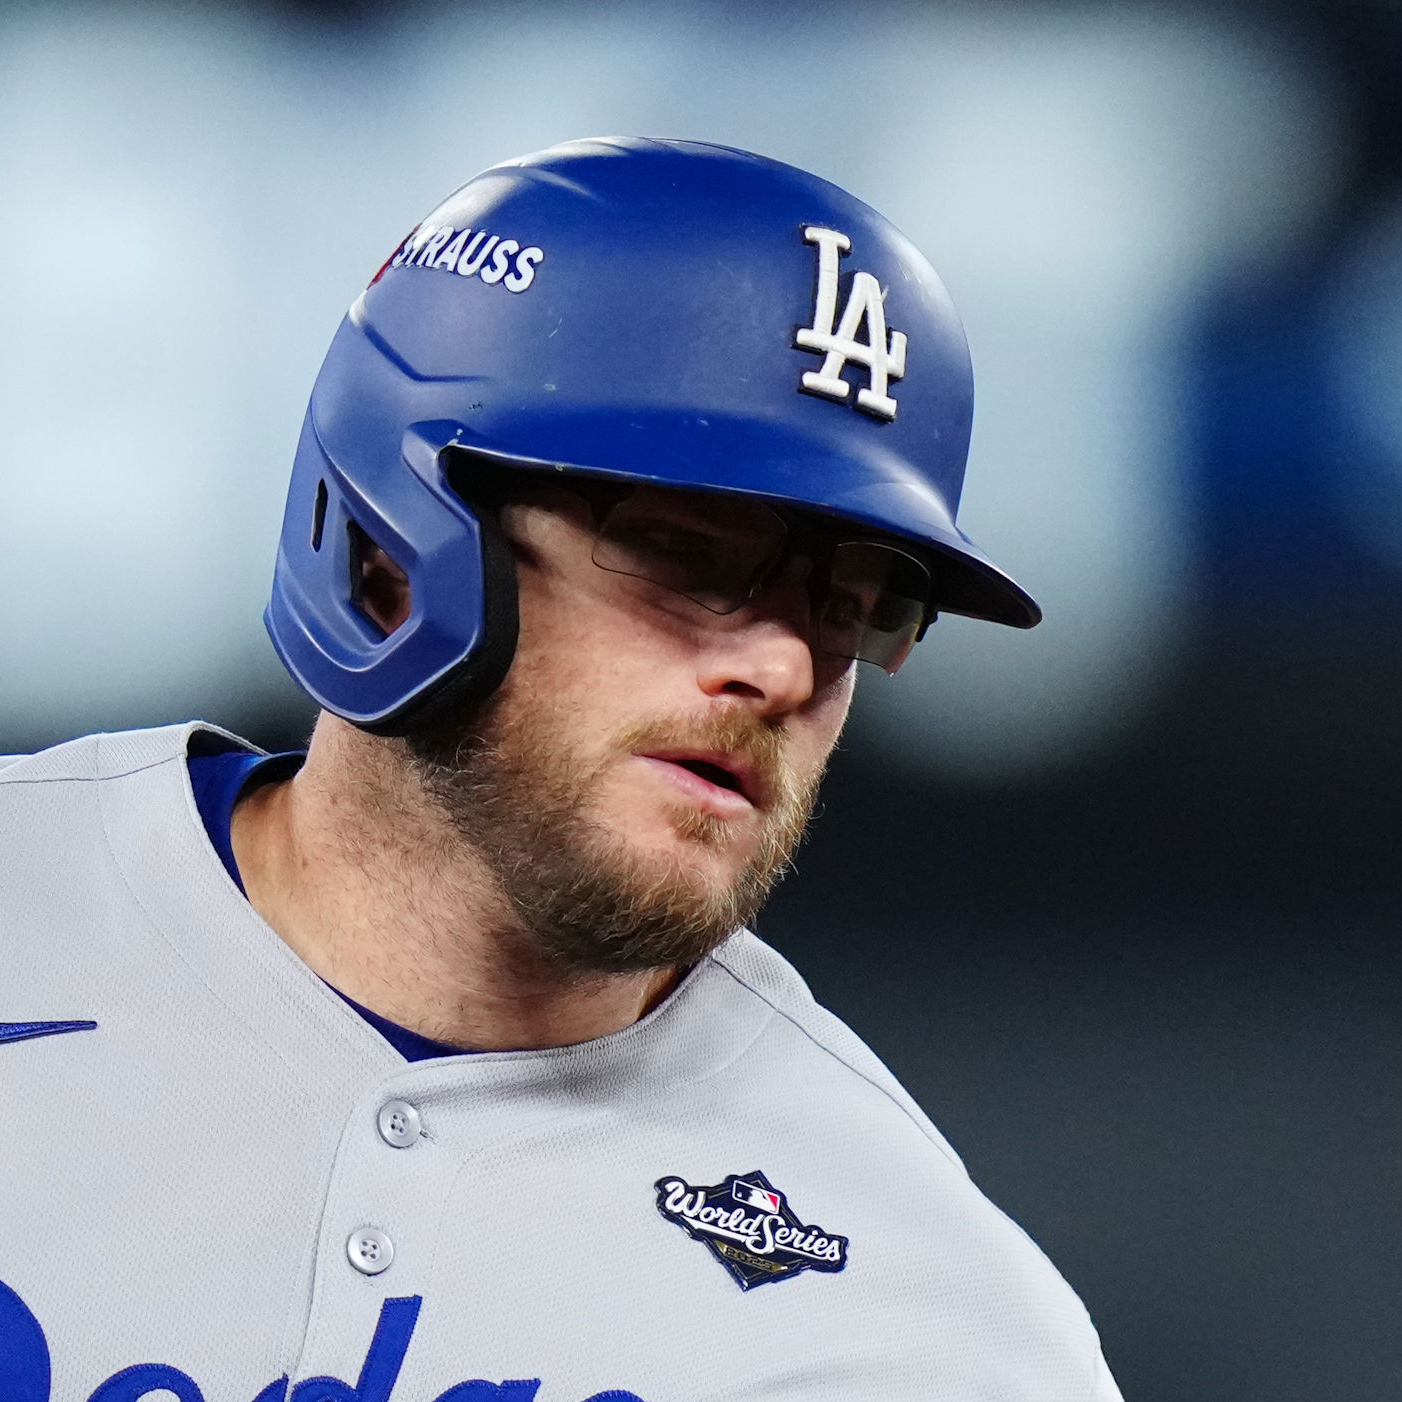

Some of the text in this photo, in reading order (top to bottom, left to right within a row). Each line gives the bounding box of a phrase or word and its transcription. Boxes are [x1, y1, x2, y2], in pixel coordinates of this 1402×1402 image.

[795, 225, 908, 418] LA
[664, 1180, 842, 1262] World Series
